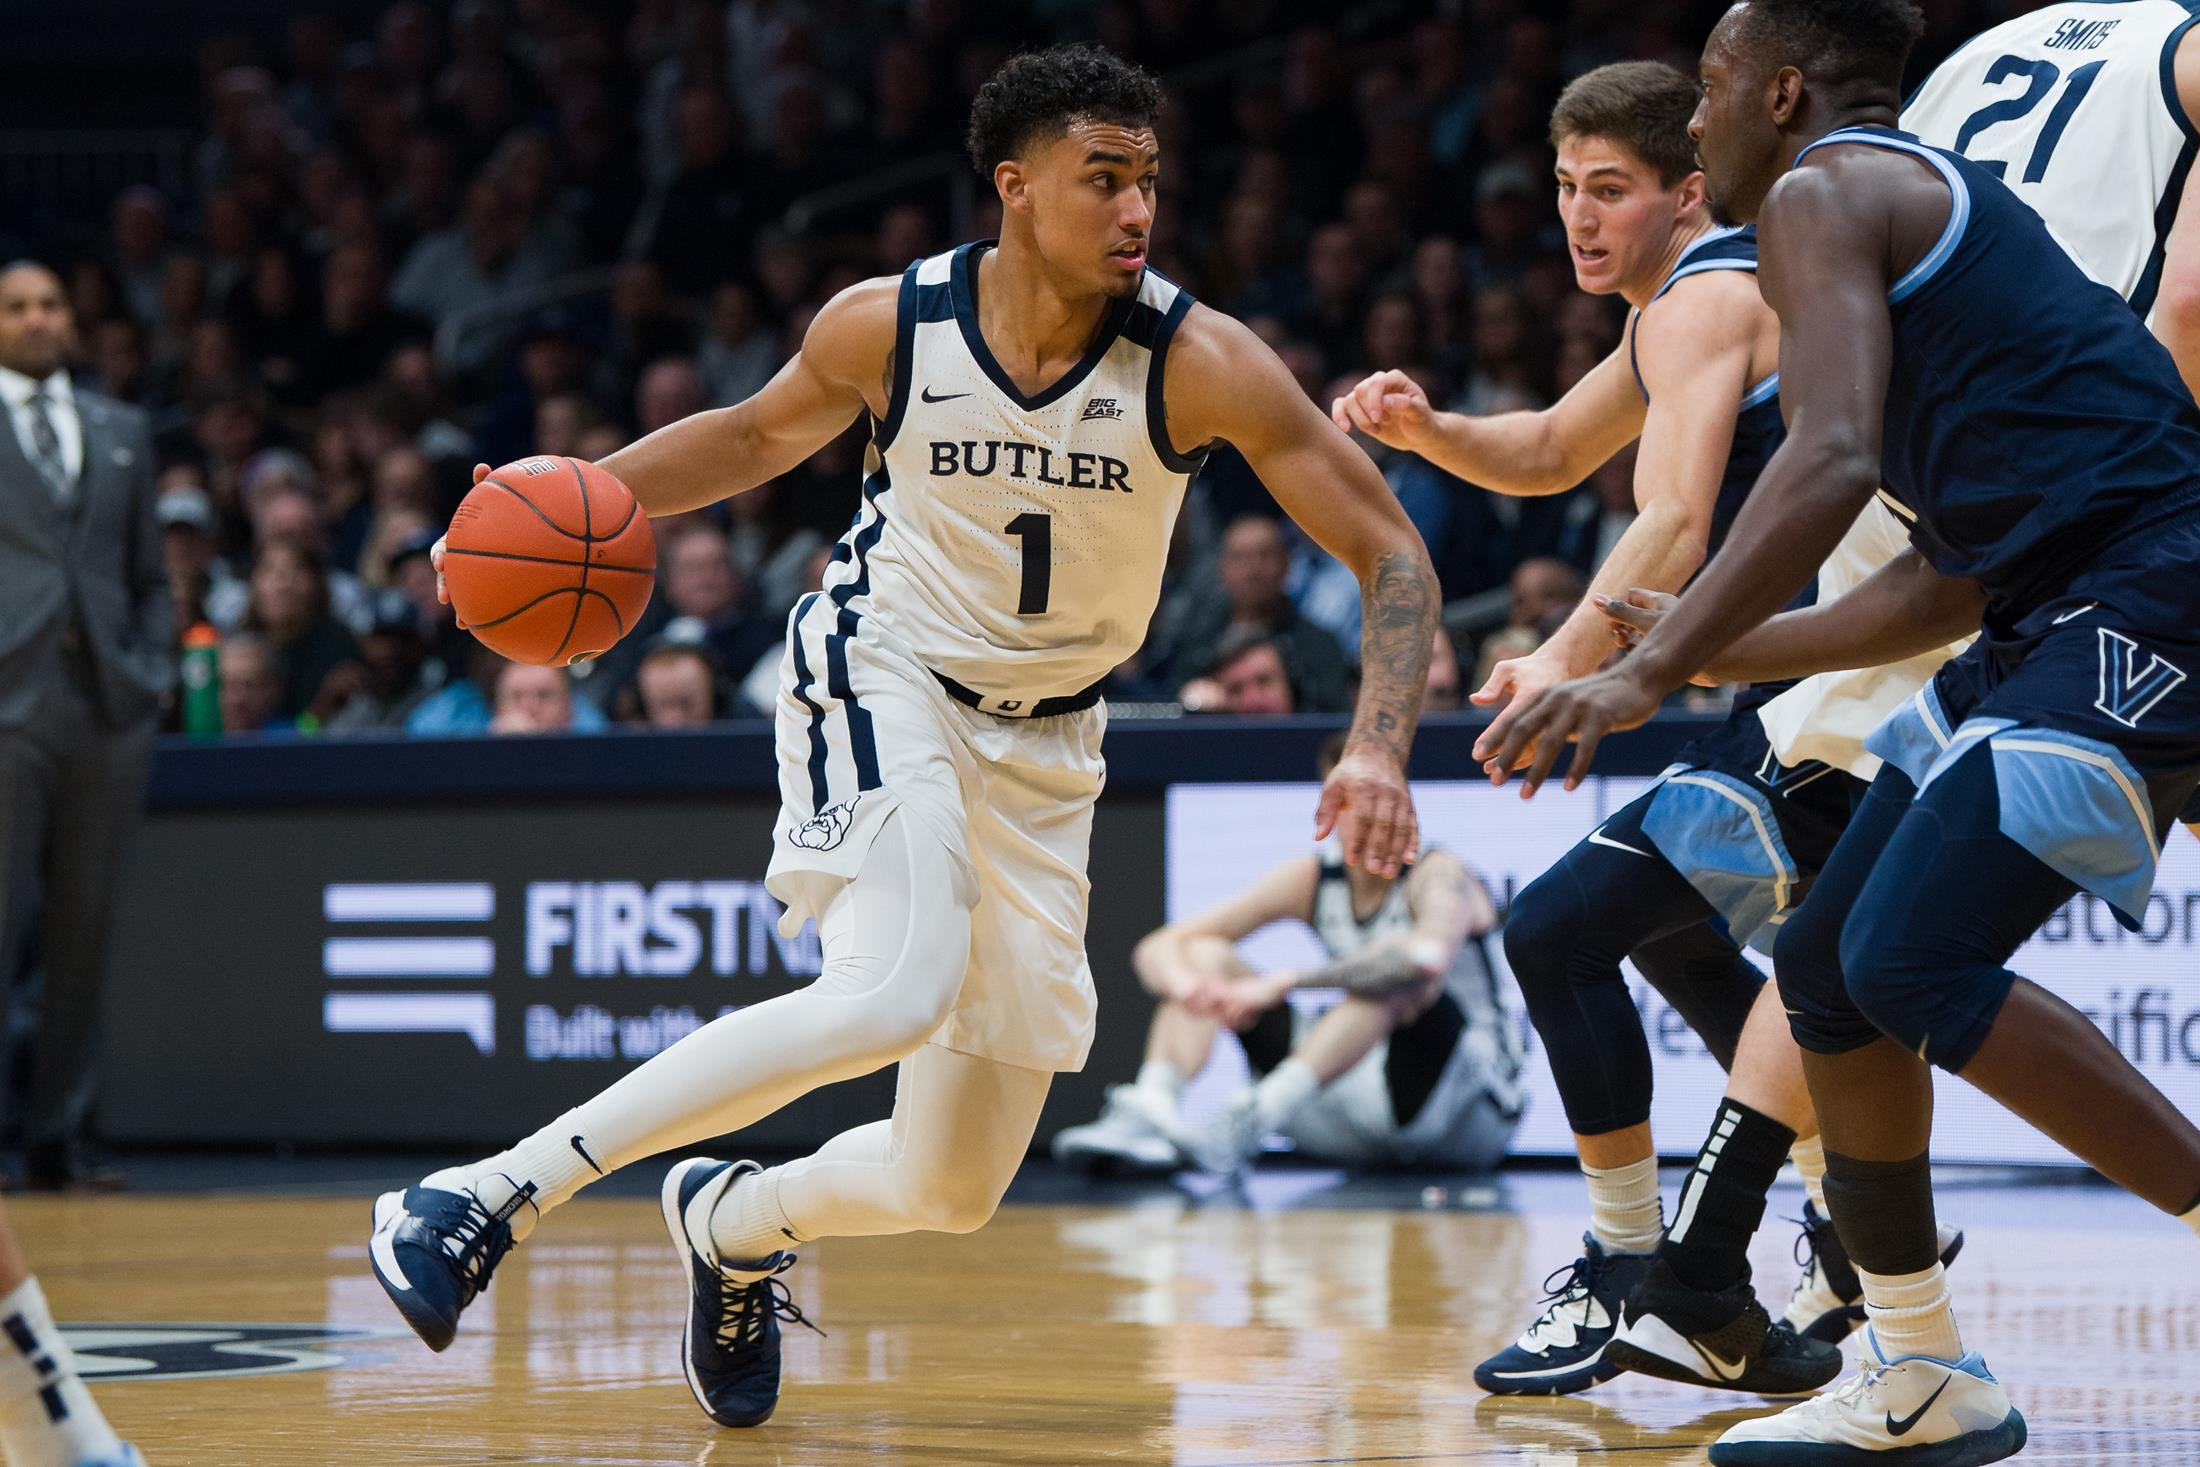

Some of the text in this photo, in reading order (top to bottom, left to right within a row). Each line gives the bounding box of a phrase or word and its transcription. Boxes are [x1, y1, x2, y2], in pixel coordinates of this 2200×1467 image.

[1954, 54, 2108, 183] 21
[1083, 407, 1124, 417] EAST
[1088, 398, 1117, 408] BIG
[929, 441, 1133, 492] BUTLER
[1004, 513, 1050, 615] 1
[2094, 627, 2186, 728] V
